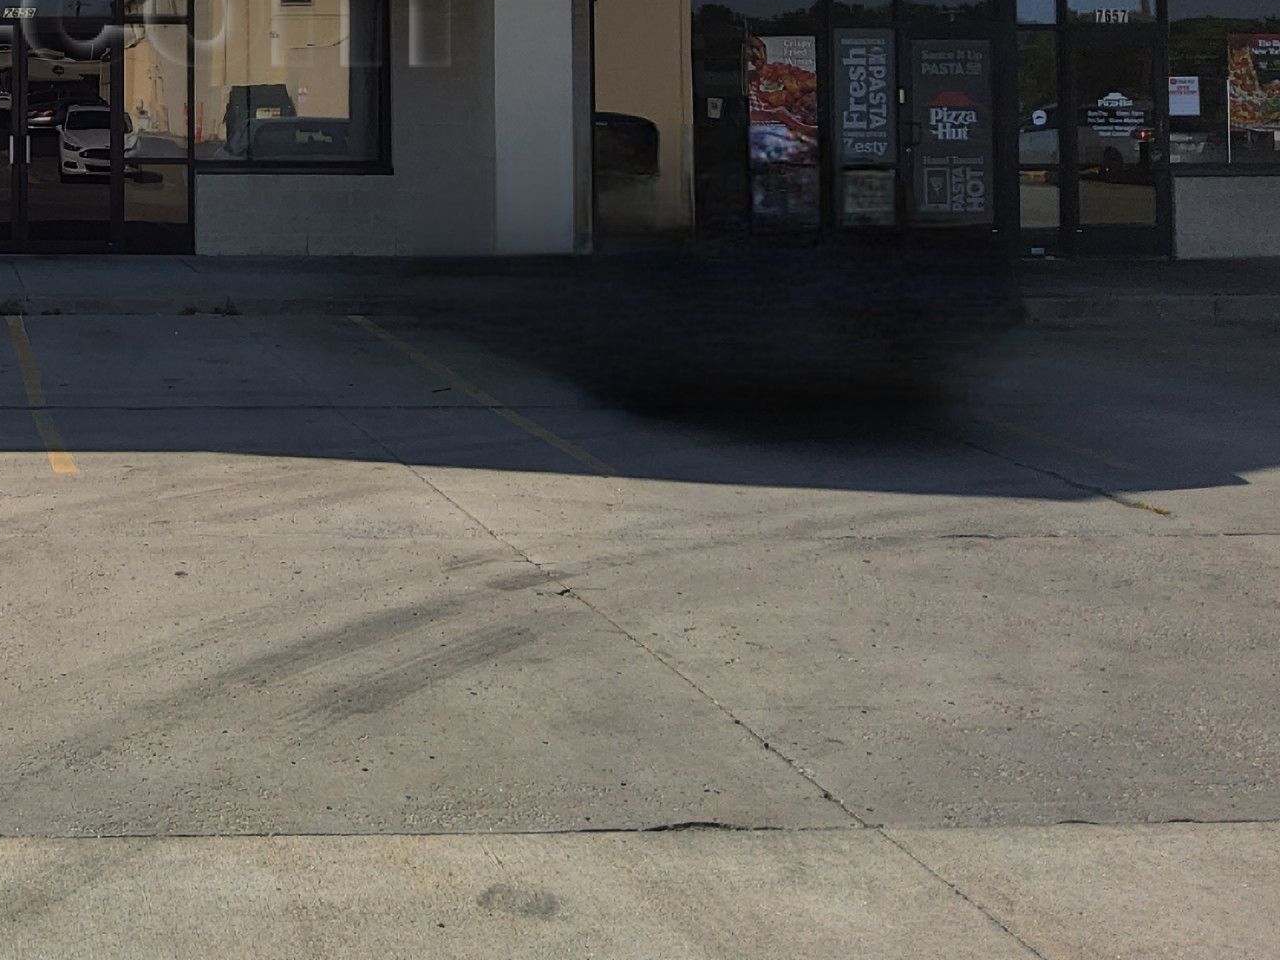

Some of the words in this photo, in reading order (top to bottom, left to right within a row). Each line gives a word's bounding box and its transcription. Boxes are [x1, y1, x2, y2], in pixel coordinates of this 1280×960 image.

[1096, 9, 1128, 23] 7657
[921, 62, 964, 75] PASTA
[842, 46, 867, 130] Fresh
[868, 66, 887, 130] PASTA
[929, 107, 977, 125] Pizza
[929, 123, 969, 141] Hut
